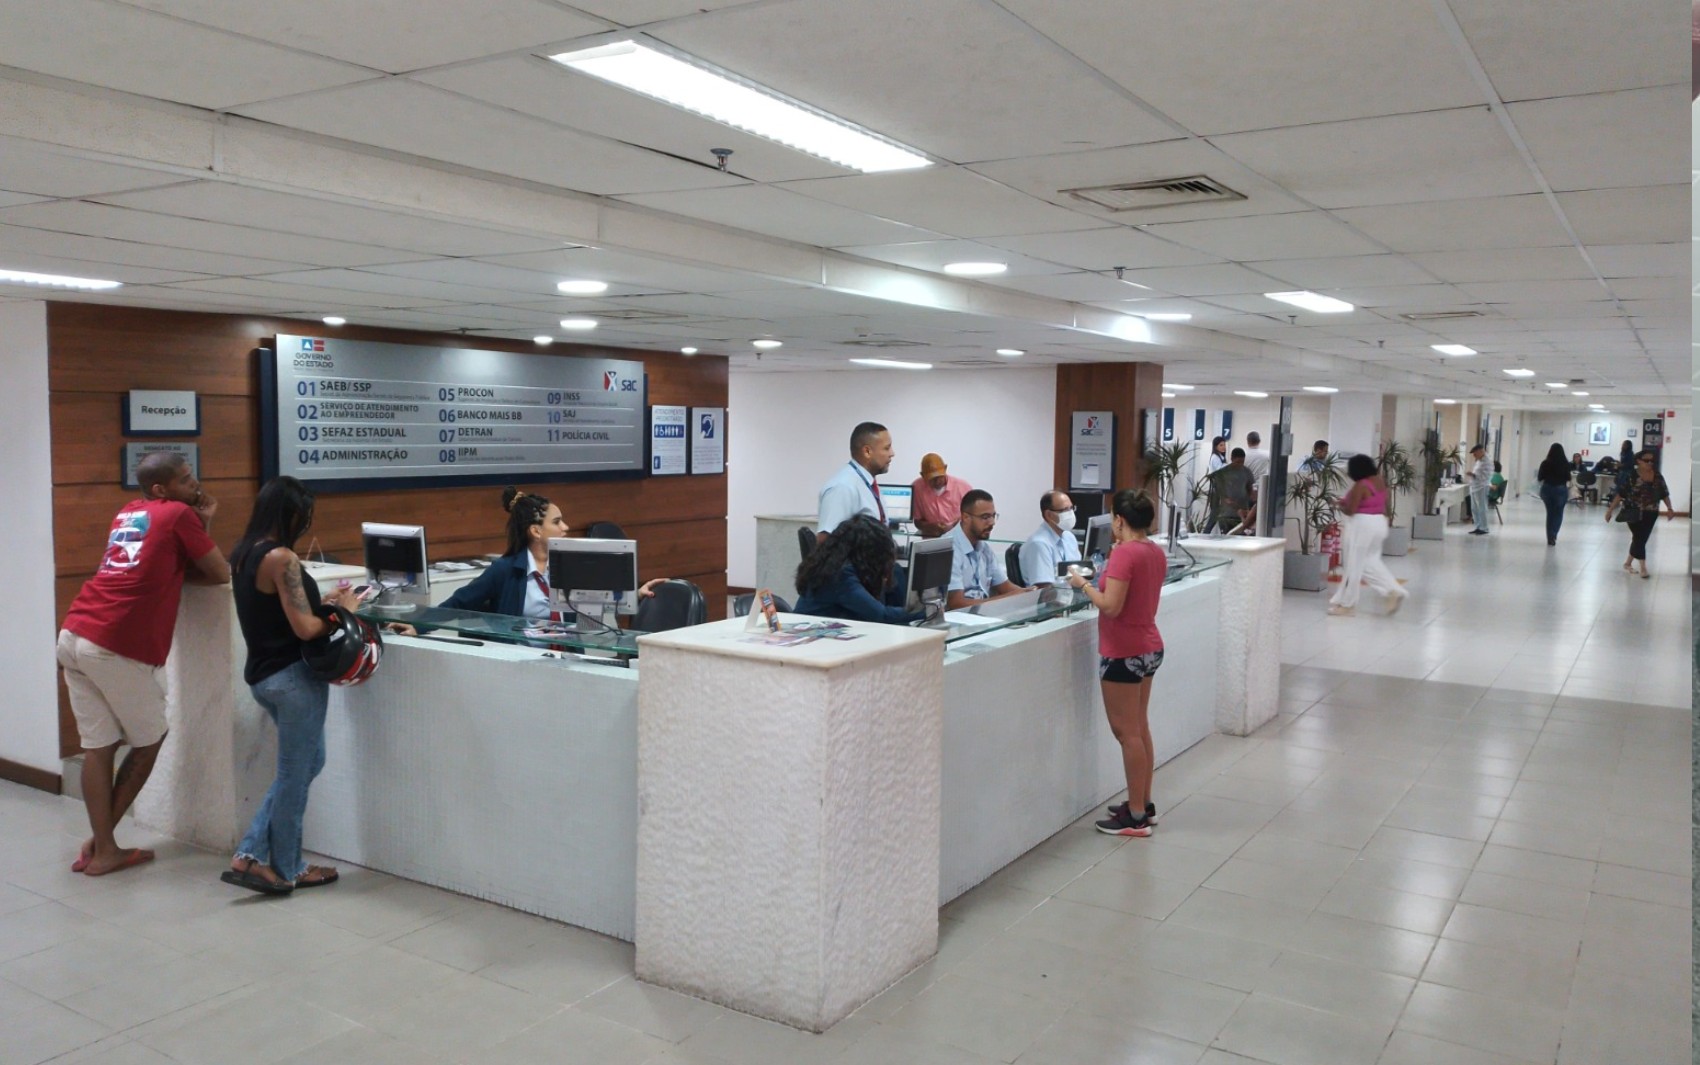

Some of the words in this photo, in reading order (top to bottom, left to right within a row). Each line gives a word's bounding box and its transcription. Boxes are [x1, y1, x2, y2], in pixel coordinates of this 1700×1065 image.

[295, 352, 332, 361] GOVERNO
[297, 381, 316, 396] 01
[353, 382, 372, 393] SSP
[621, 379, 637, 392] sac
[438, 388, 455, 401] 05
[458, 387, 494, 398] PROCON
[547, 392, 561, 405] 09
[563, 392, 580, 401] INSS
[141, 405, 187, 416] Recepção
[297, 404, 318, 420] 02
[320, 402, 354, 412] SERVIÇO
[355, 403, 366, 411] DE
[366, 404, 419, 413] ATENDIMENTO
[333, 411, 395, 419] EMPREENDEDOR
[438, 409, 456, 423] 06
[457, 410, 488, 420] BANCO
[489, 410, 510, 420] MAIS
[547, 411, 561, 424] 10
[562, 409, 576, 418] SAJ
[298, 426, 319, 441] 03
[322, 427, 354, 438] SEFAZ
[355, 427, 407, 438] ESTADUAL
[1165, 428, 1172, 437] 5
[1196, 428, 1203, 437] 6
[1224, 428, 1230, 437] 7
[1644, 423, 1660, 432] 04
[439, 429, 456, 443] 07
[458, 427, 493, 437] DETRAN
[547, 429, 560, 442] 11
[562, 429, 591, 440] POLÍCIA
[592, 431, 610, 441] CIVIL
[298, 449, 320, 464] 04
[322, 448, 408, 462] ADMINISTRAÇÃO
[439, 449, 456, 463] 08
[458, 447, 477, 457] IIPM
